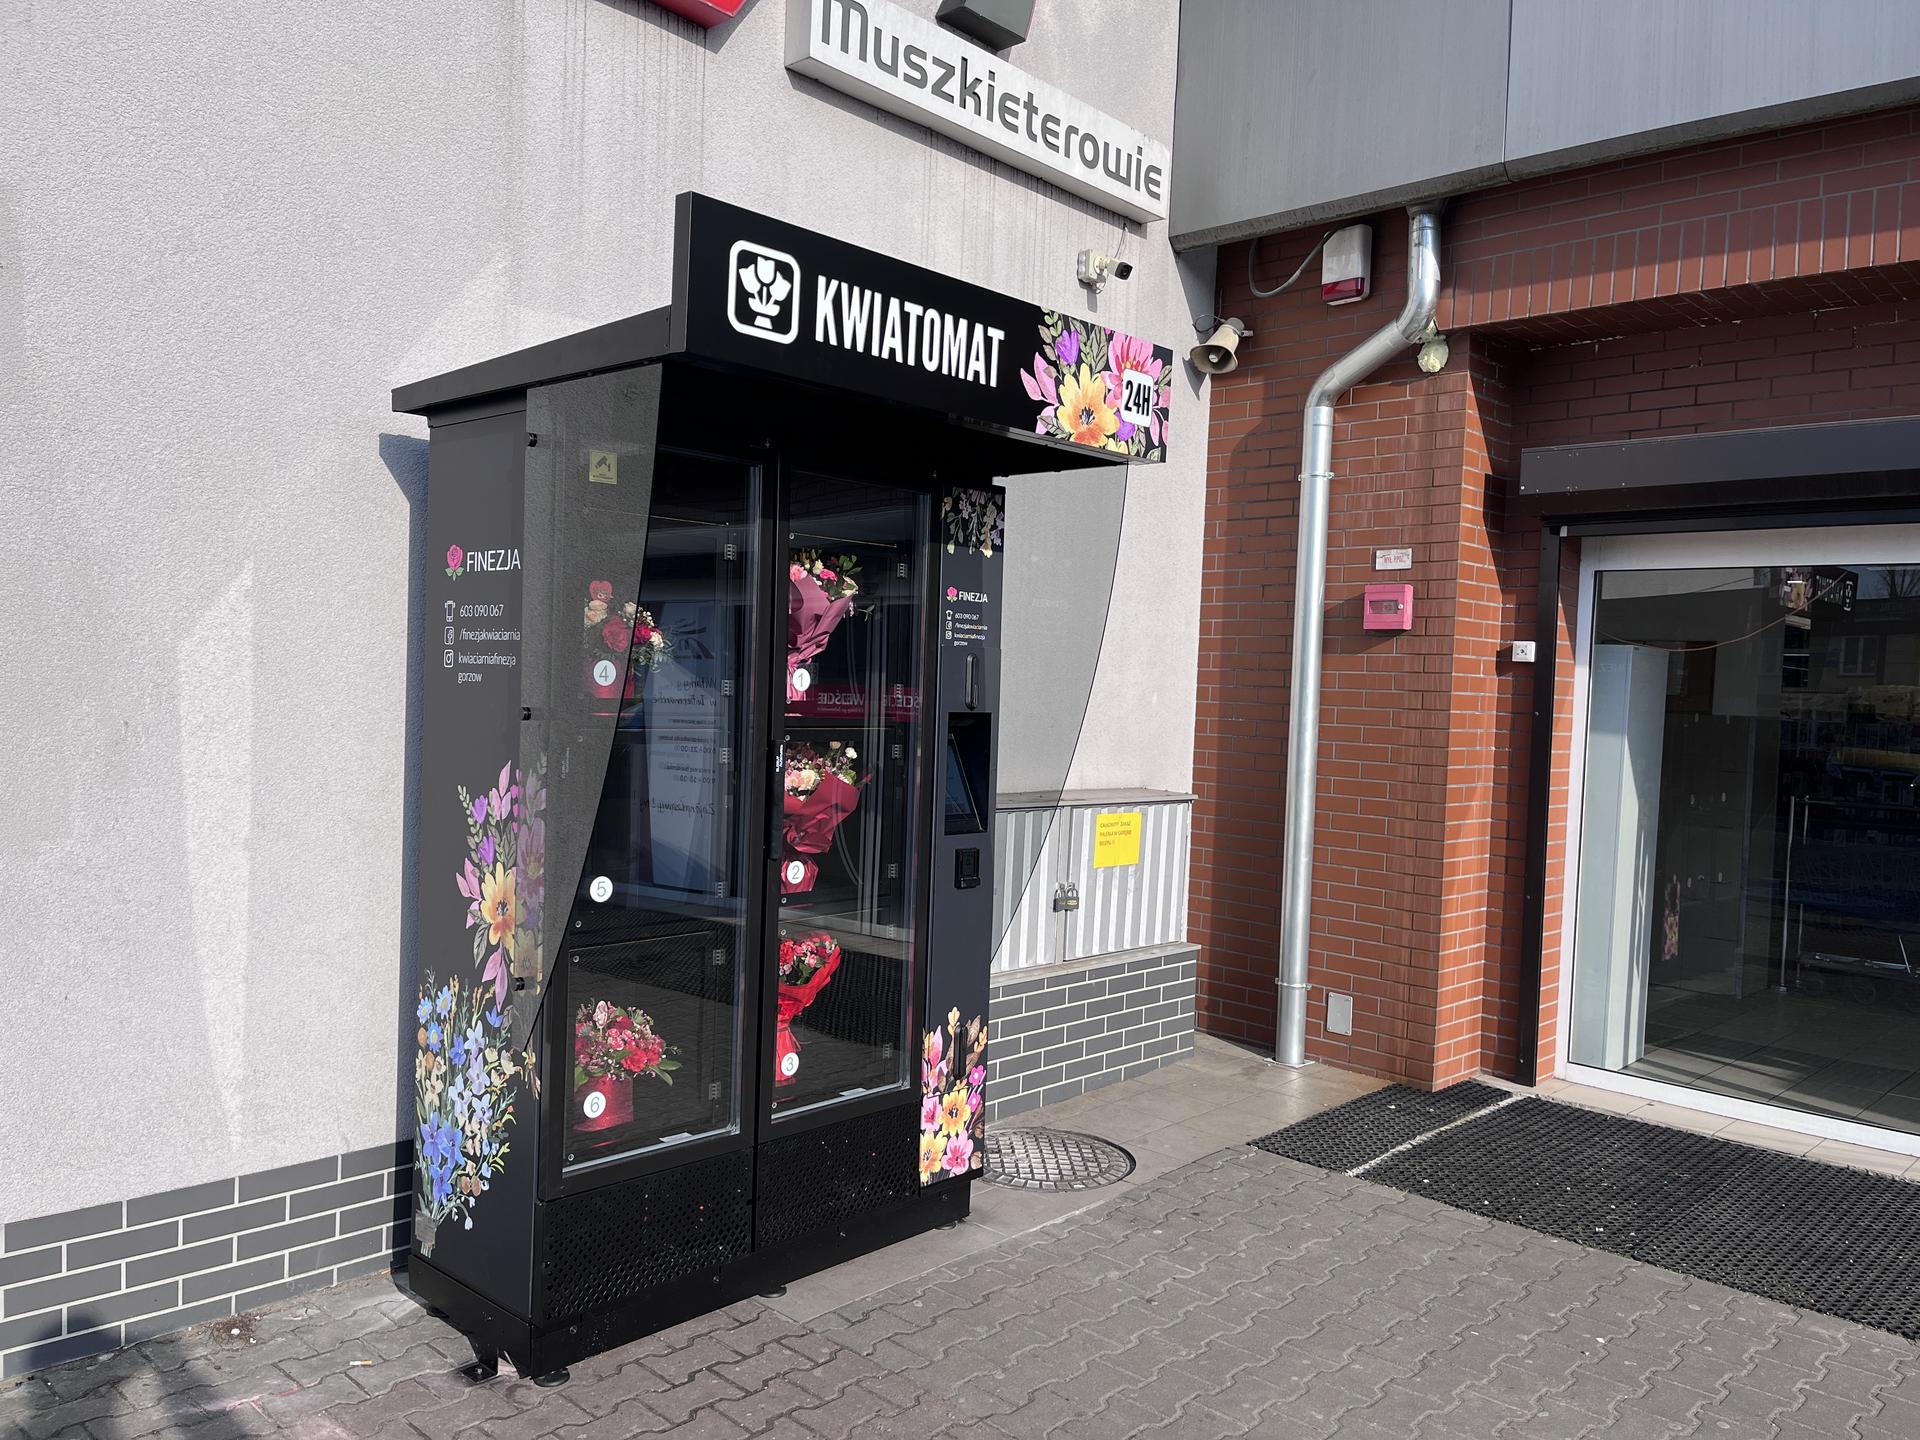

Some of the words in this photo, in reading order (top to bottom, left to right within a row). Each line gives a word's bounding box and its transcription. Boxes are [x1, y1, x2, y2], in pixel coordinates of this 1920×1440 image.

[815, 274, 1005, 388] KWIATOMAT
[1123, 379, 1152, 417] 24H
[466, 549, 521, 572] FINEZJA
[958, 591, 988, 603] FINEZJA
[459, 606, 474, 617] 603
[474, 605, 488, 617] 090
[489, 604, 504, 616] 067
[599, 664, 609, 682] 4
[797, 672, 805, 688] 1
[791, 865, 800, 880] 2
[597, 881, 607, 897] 5
[786, 1056, 794, 1071] 3
[590, 1096, 600, 1113] 6
